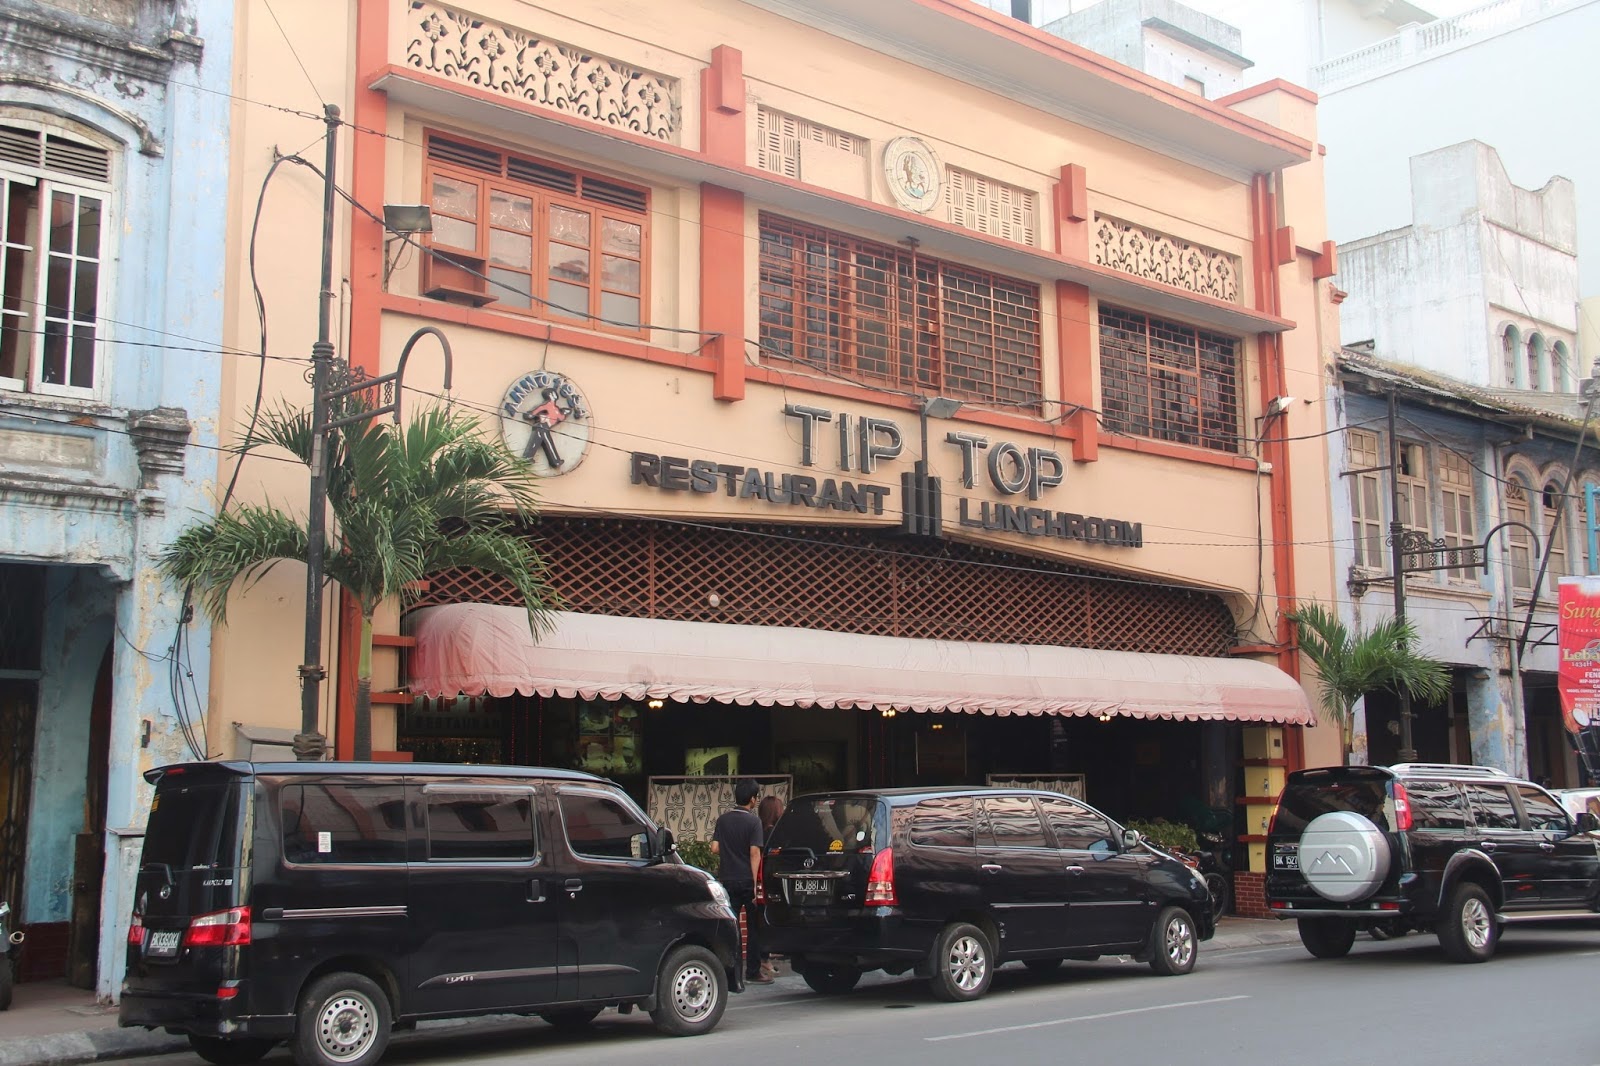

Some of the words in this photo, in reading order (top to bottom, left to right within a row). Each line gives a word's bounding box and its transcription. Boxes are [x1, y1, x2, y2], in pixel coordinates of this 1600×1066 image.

[785, 404, 904, 474] TIP
[945, 431, 1067, 501] TOP
[631, 451, 890, 516] RESTAURANT
[959, 498, 1142, 548] LUNCHROOM
[795, 880, 804, 889] BK
[1275, 856, 1284, 865] BK
